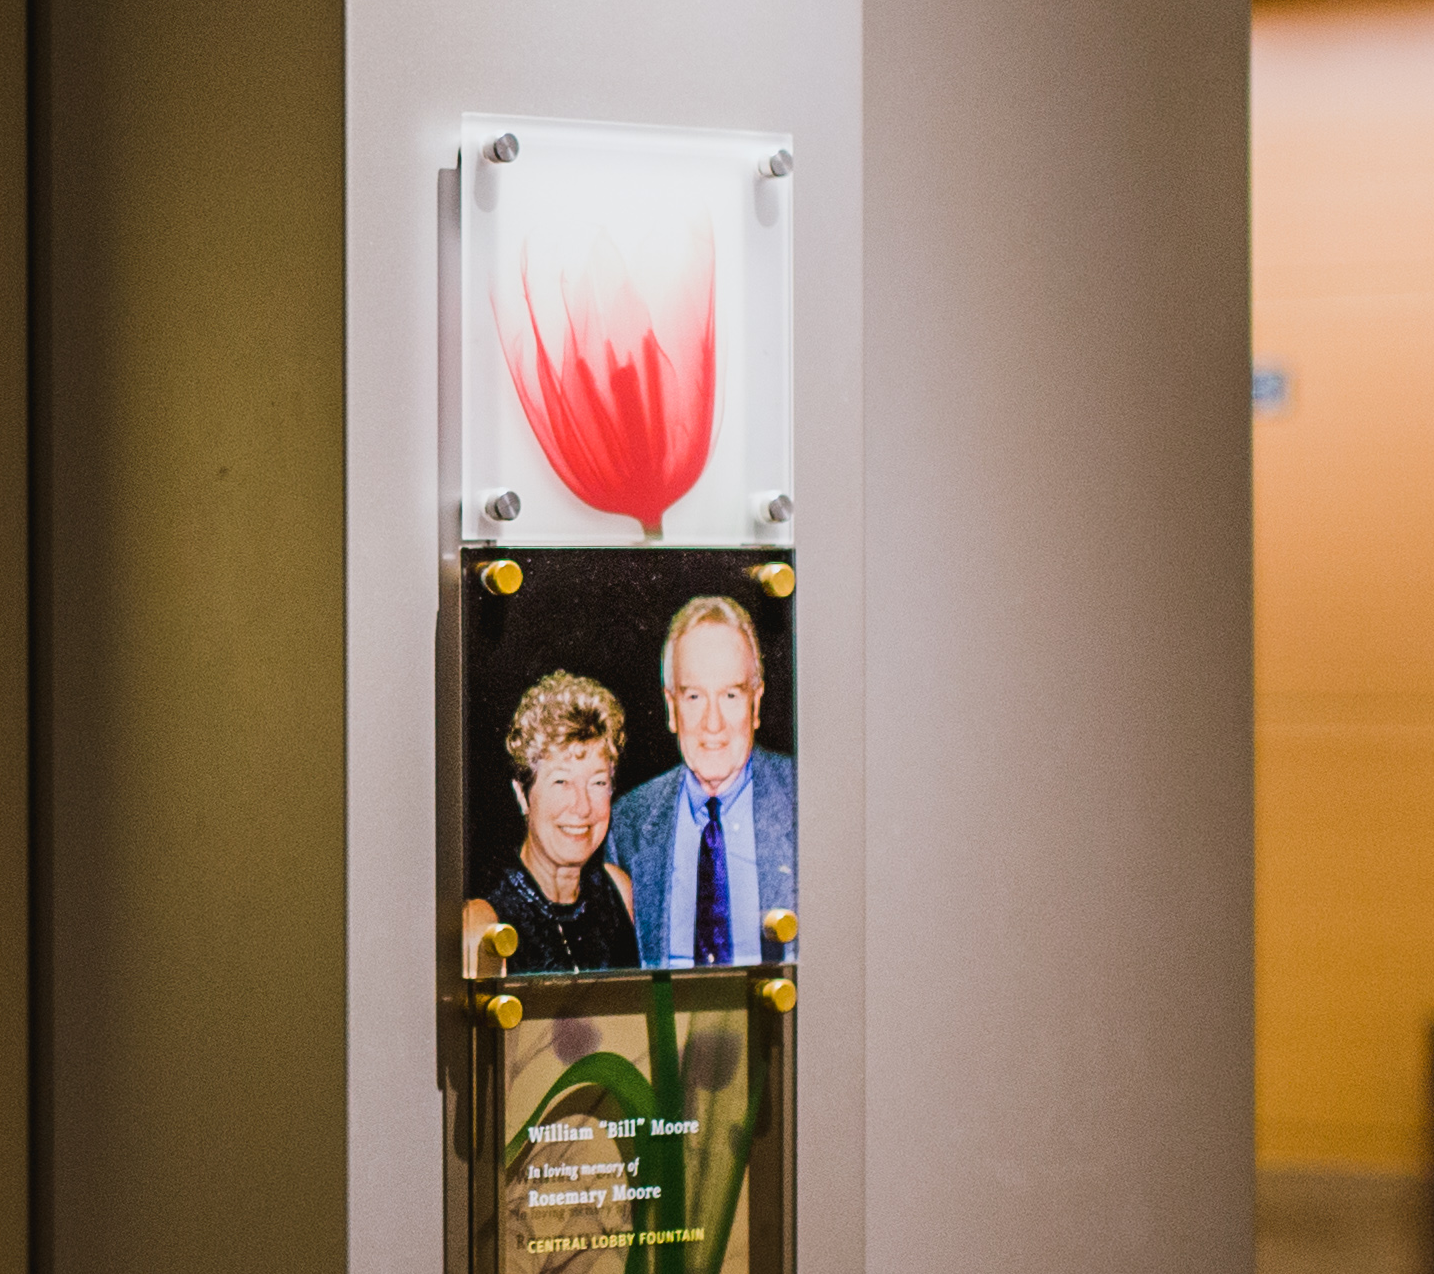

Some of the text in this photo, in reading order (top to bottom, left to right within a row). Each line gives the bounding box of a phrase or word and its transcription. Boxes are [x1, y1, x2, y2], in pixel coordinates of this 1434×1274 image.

[528, 1125, 594, 1143] William
[651, 1119, 699, 1136] Moore
[528, 1157, 640, 1181] In loving memory of
[528, 1185, 662, 1208] Rosemary Moore
[528, 1228, 705, 1254] CENTRAL LOBBY FOUNTAIN
